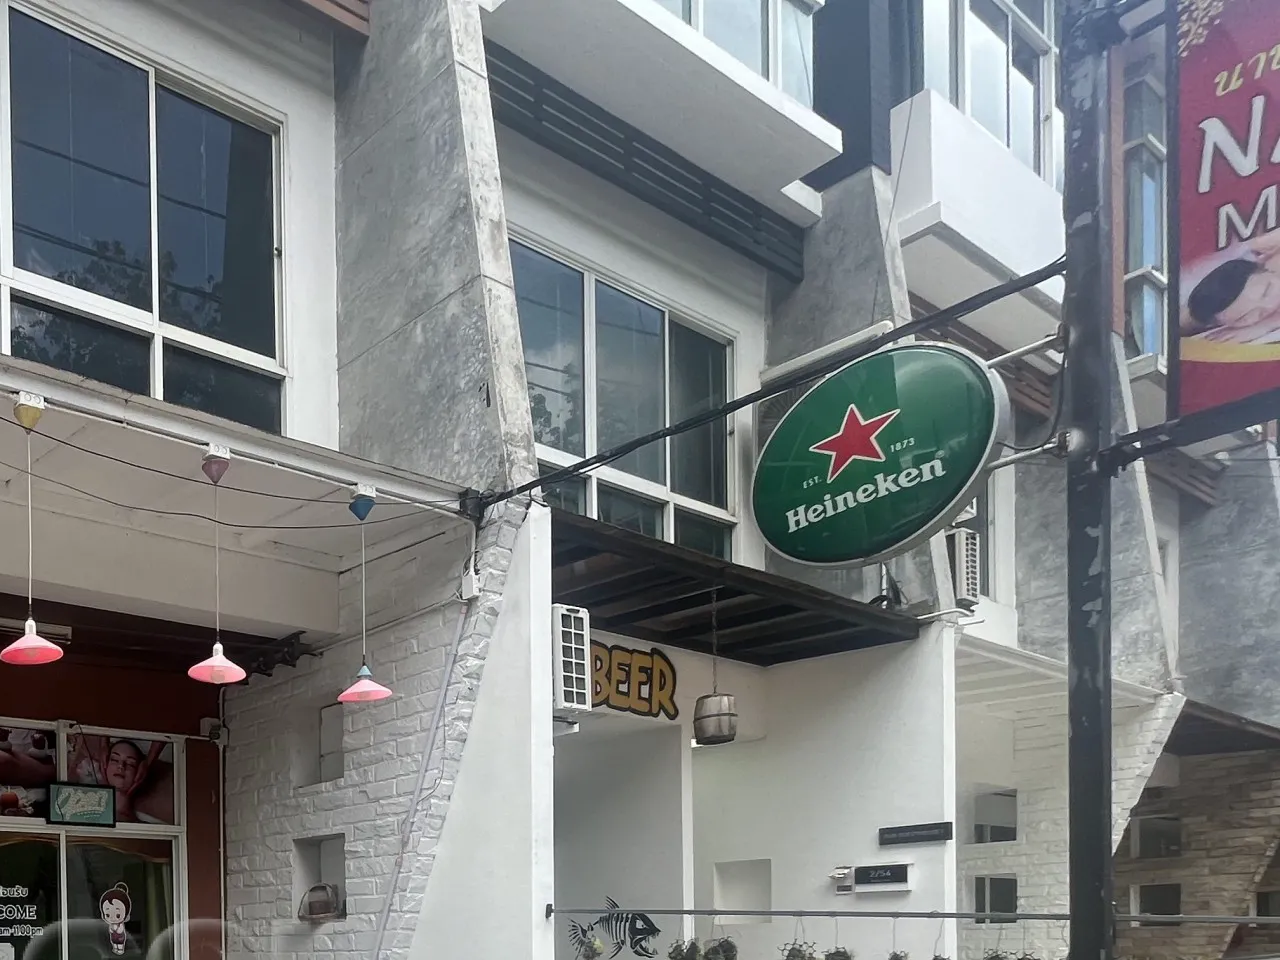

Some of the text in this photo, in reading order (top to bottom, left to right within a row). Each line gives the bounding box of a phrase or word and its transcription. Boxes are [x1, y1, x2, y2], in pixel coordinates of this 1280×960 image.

[1198, 94, 1280, 194] N
[802, 474, 822, 489] EST.
[890, 437, 916, 453] 1873
[785, 458, 947, 533] Heineken
[589, 639, 679, 720] BEER
